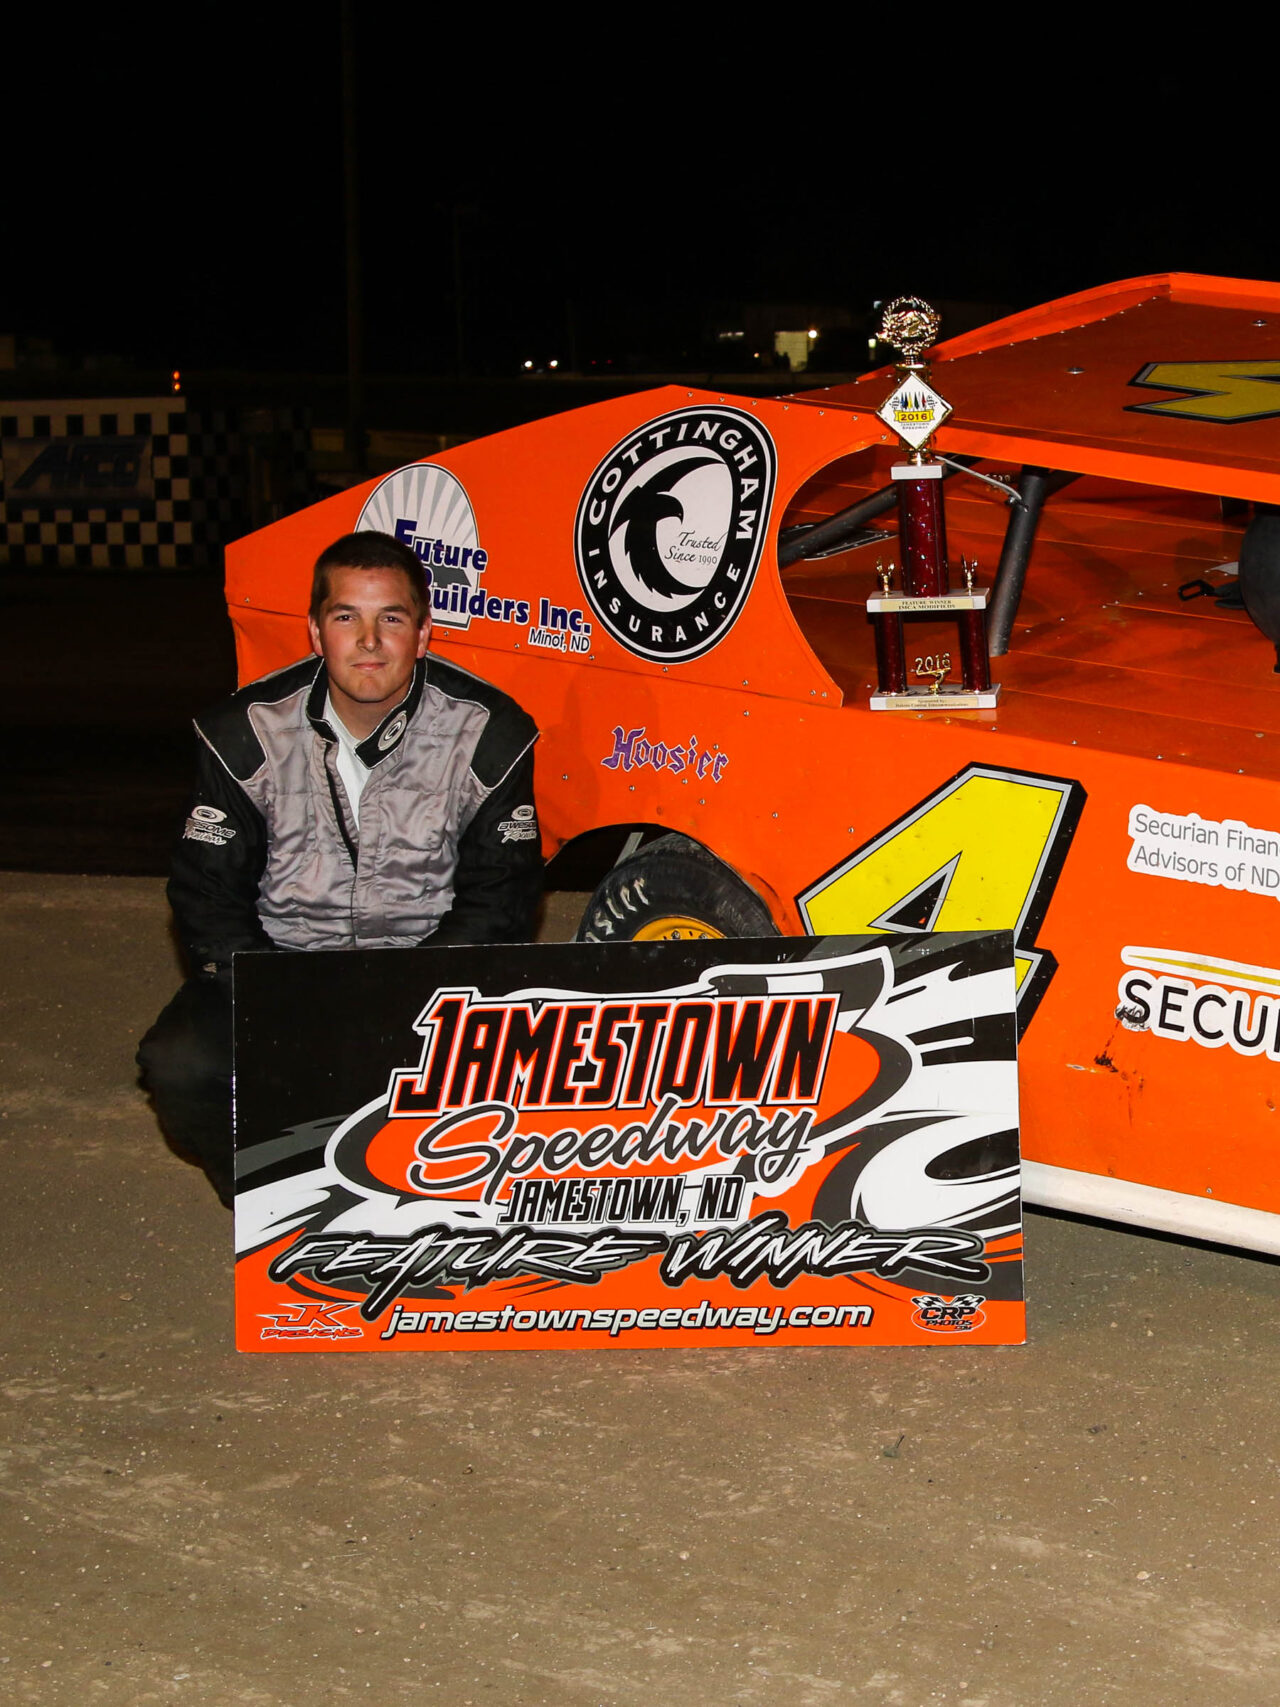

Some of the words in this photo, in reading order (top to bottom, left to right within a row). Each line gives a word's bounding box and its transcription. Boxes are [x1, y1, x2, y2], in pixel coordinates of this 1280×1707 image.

[900, 413, 928, 421] 2016
[589, 420, 760, 540] COTTINGHAM
[394, 518, 488, 571] Future
[664, 546, 697, 563] Since
[698, 554, 718, 565] 1990
[678, 530, 728, 551] Trusted
[588, 548, 742, 643] INSURANCE
[539, 598, 592, 635] Inc.
[528, 627, 567, 653] Minot,
[570, 635, 590, 653] ND
[915, 653, 951, 674] 2016
[600, 725, 729, 783] Hoosier
[1134, 812, 1219, 846] Securian
[1134, 845, 1219, 879] Advisors
[1224, 862, 1246, 883] of
[793, 761, 1088, 1045] 4
[390, 989, 840, 1117] JAMESTOWN
[410, 1094, 816, 1204] Speedway
[499, 1176, 688, 1228] JAMESTOWN,
[693, 1174, 748, 1222] ND
[274, 1228, 661, 1316] FEATURE
[663, 1213, 989, 1285] WINNER
[257, 1302, 361, 1328] JK
[380, 1299, 873, 1340] jamestownspeedway.com
[920, 1306, 977, 1320] CRP
